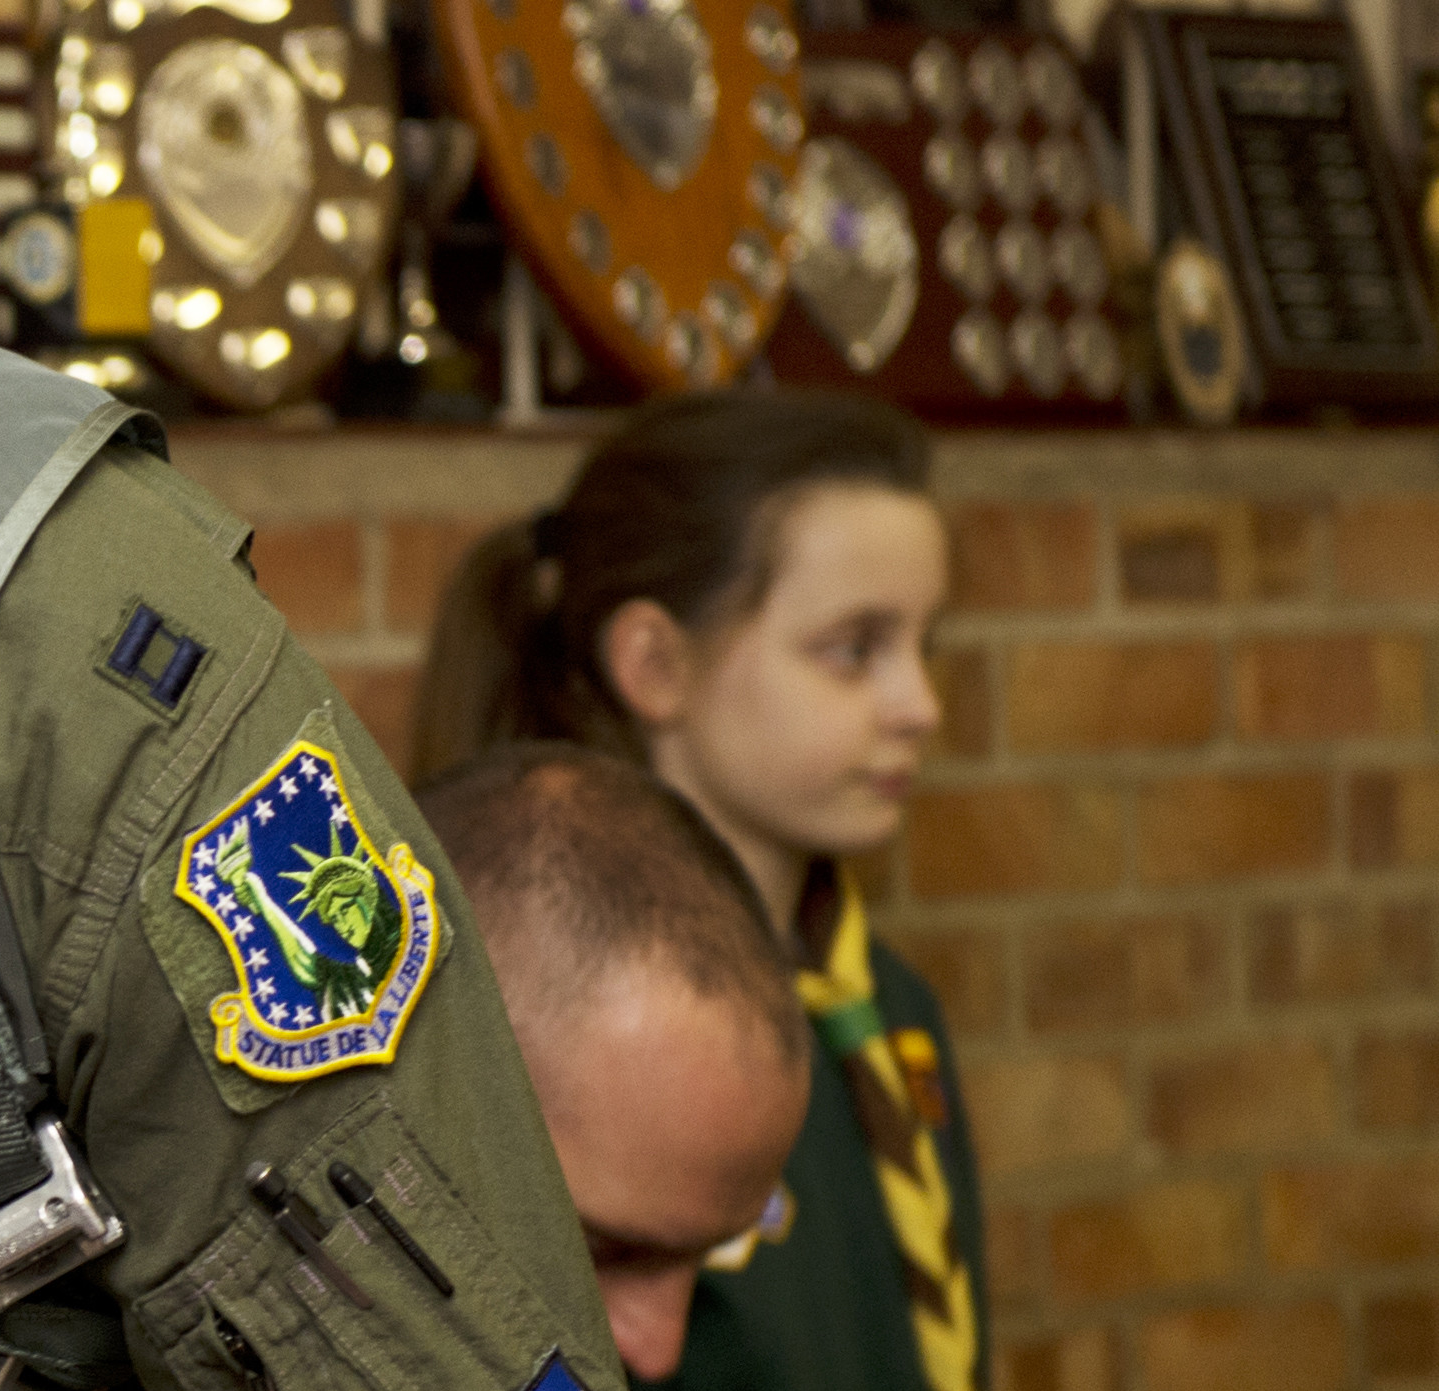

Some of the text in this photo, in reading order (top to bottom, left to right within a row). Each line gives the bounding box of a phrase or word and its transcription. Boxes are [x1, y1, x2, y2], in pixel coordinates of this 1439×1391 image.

[239, 1030, 330, 1068] STATUE
[336, 1028, 366, 1056] DE
[370, 1010, 398, 1048] LA
